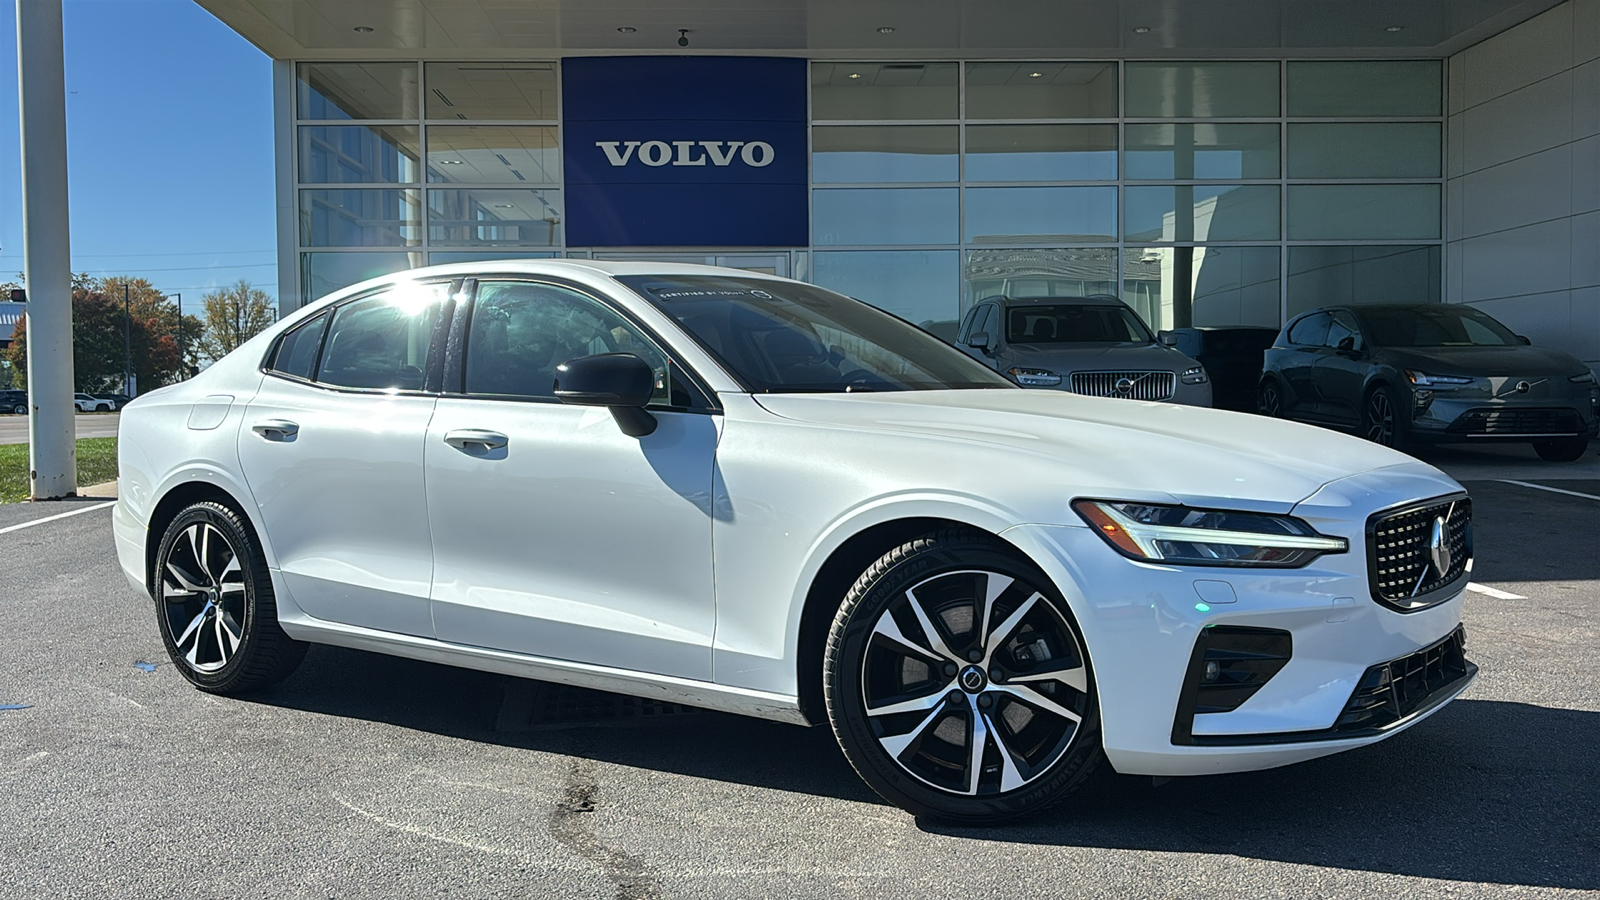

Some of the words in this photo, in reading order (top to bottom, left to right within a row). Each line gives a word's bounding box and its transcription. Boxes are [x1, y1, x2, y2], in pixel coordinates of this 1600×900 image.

[595, 140, 775, 167] VOLVO
[660, 291, 705, 299] CERTIFIED
[866, 559, 928, 611] GOODYEAR
[1018, 754, 1083, 805] ASSURANCE
